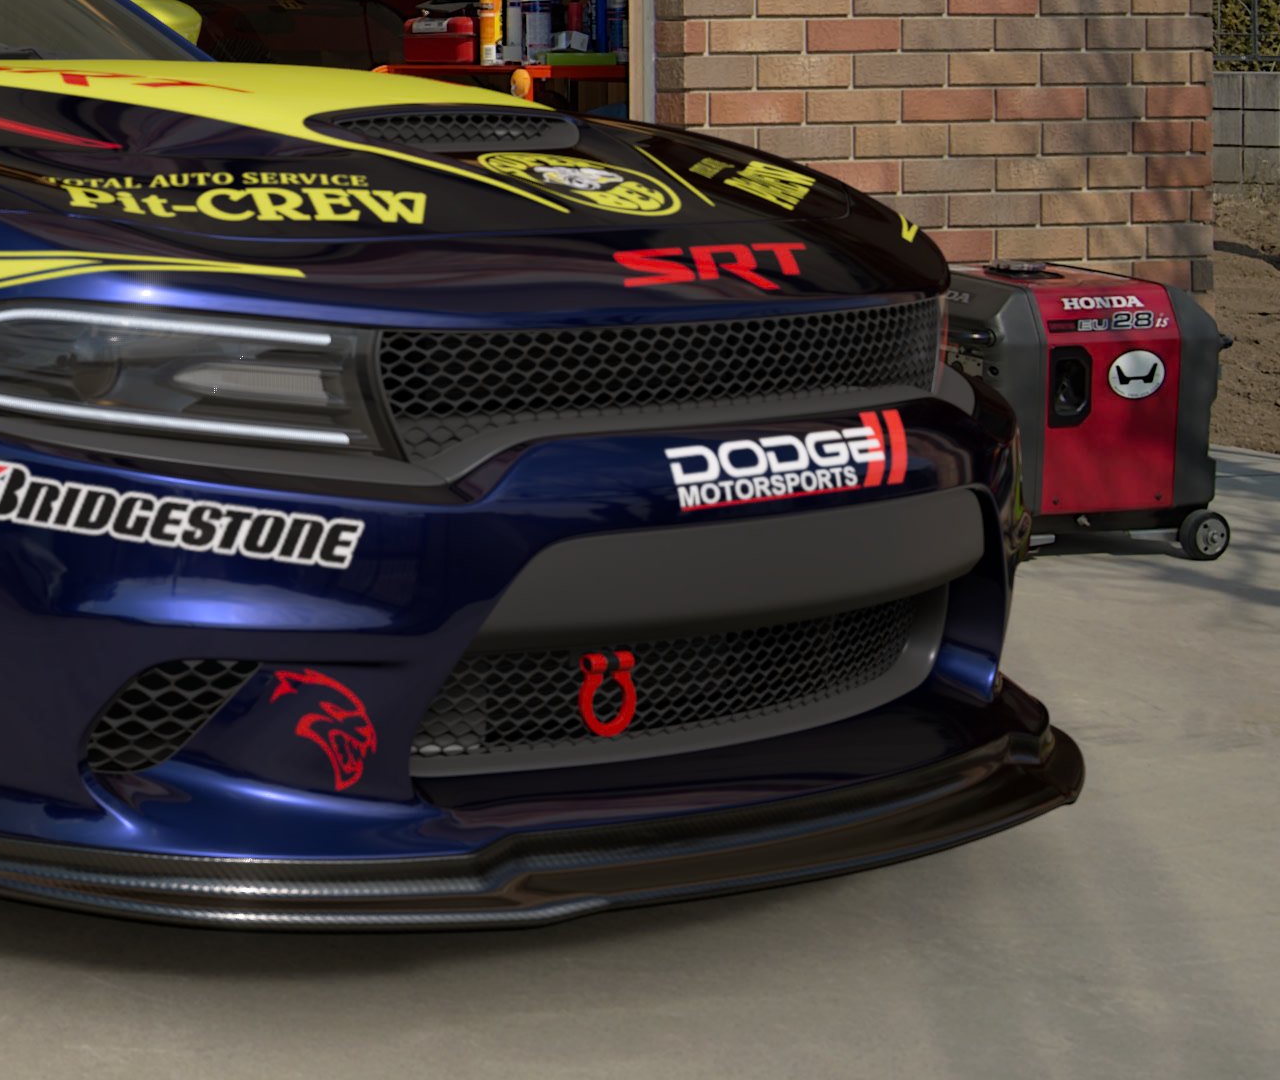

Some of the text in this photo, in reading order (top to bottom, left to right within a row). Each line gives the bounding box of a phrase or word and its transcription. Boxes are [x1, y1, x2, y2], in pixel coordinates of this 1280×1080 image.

[45, 172, 368, 189] TOTAL AUTO SERVICE
[63, 185, 428, 224] Pit-CREW
[613, 243, 806, 290] SRT
[1060, 295, 1145, 311] HONDA
[664, 426, 886, 486] DODGE
[677, 465, 859, 508] MOTORSPORTS
